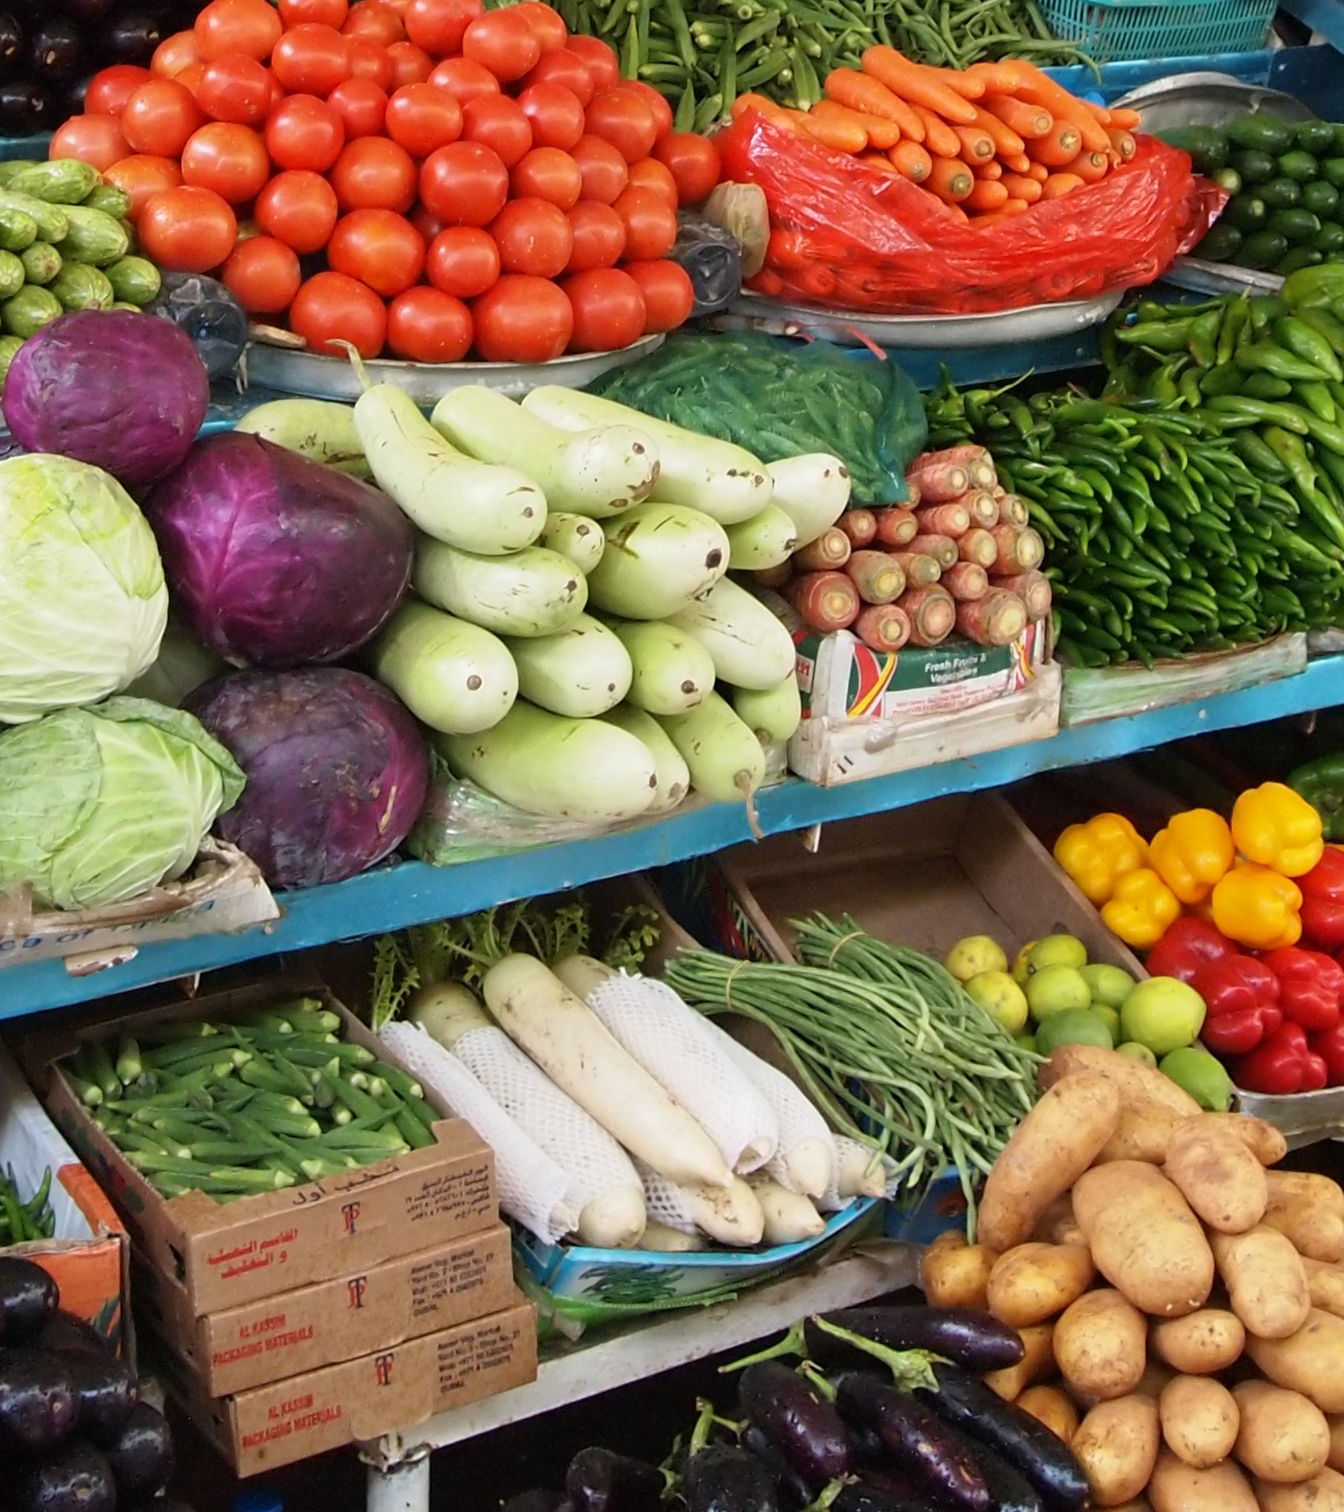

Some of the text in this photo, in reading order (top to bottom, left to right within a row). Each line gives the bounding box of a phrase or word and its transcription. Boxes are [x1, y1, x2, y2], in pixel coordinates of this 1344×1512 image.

[924, 660, 952, 673] Fresh
[239, 1314, 286, 1339] AL KASSIM
[213, 1326, 314, 1366] PACKAGING MATERIALS
[267, 1393, 314, 1421] AL KASSIM
[242, 1405, 343, 1448] PACKAGING MATERIALS
